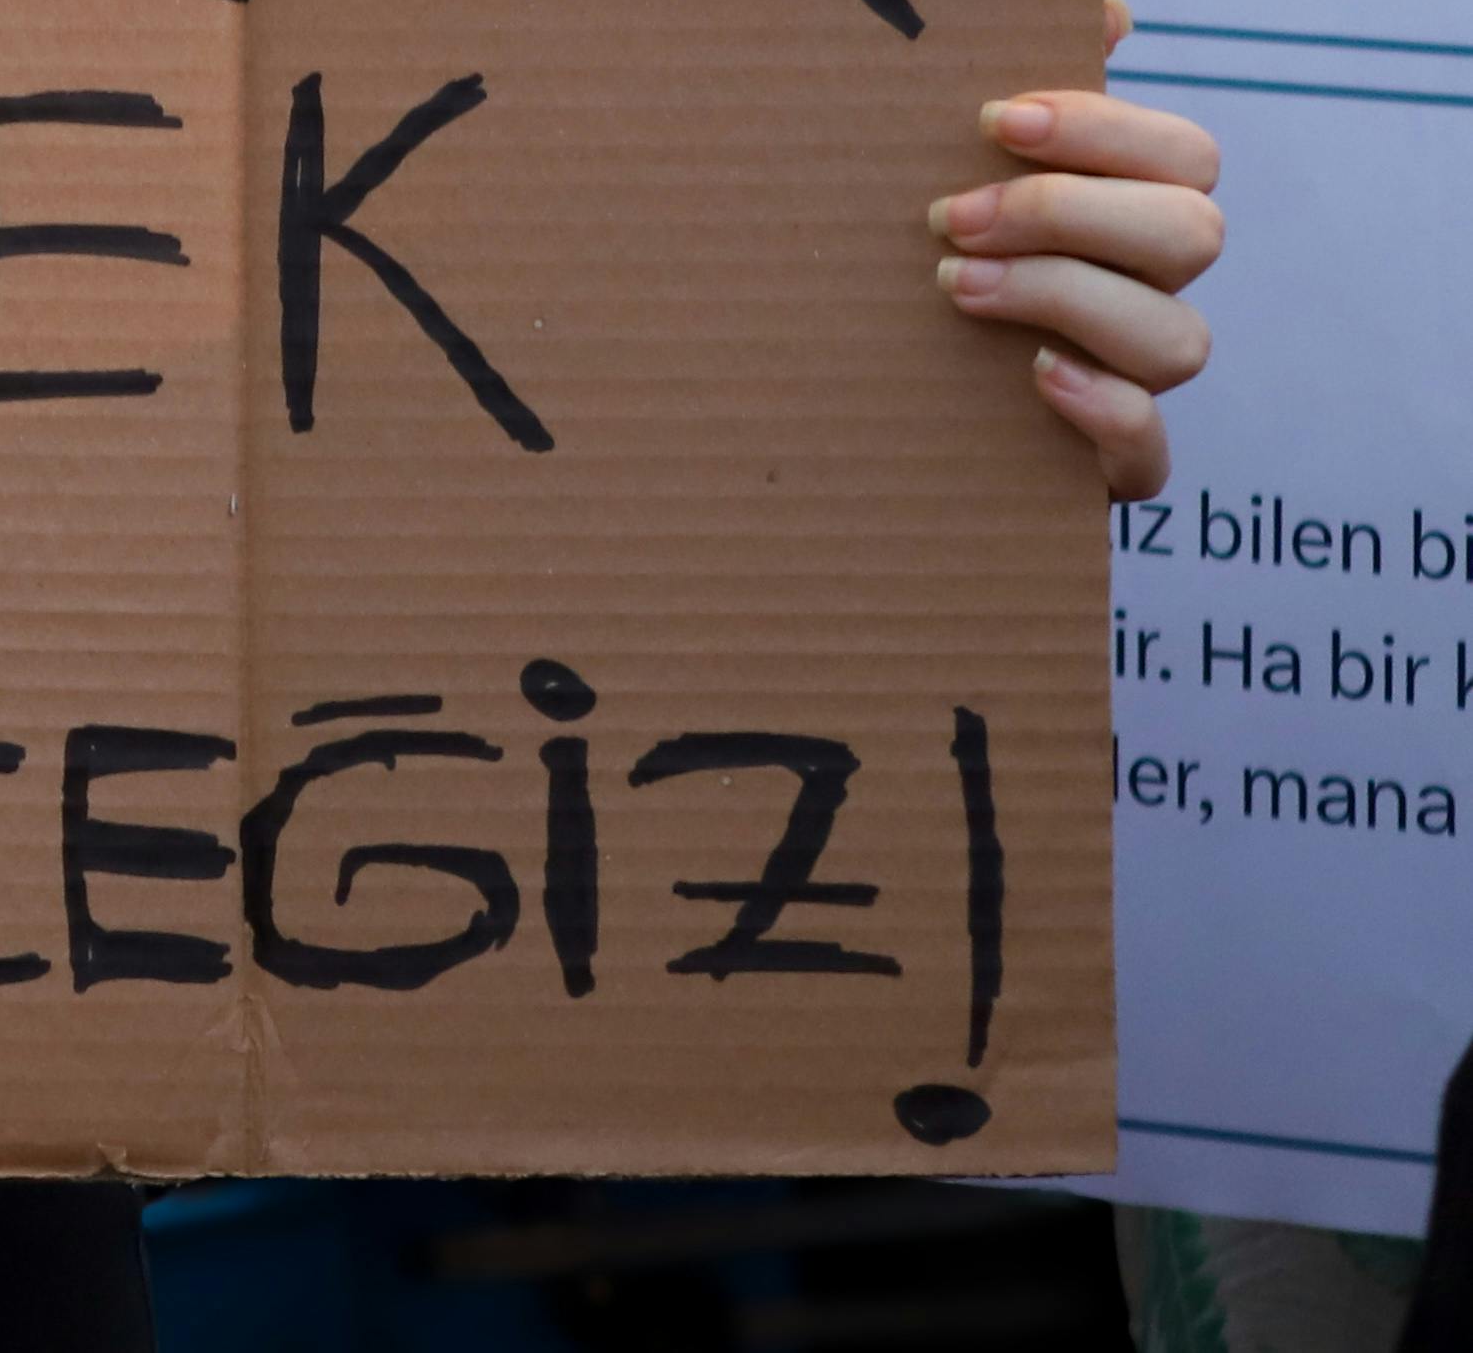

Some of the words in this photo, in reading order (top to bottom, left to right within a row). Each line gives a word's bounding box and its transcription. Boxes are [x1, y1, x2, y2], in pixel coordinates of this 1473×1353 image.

[1199, 488, 1383, 577] bilen
[1201, 620, 1302, 697] Ha
[1330, 628, 1431, 707] bir
[1242, 766, 1457, 838] mana
